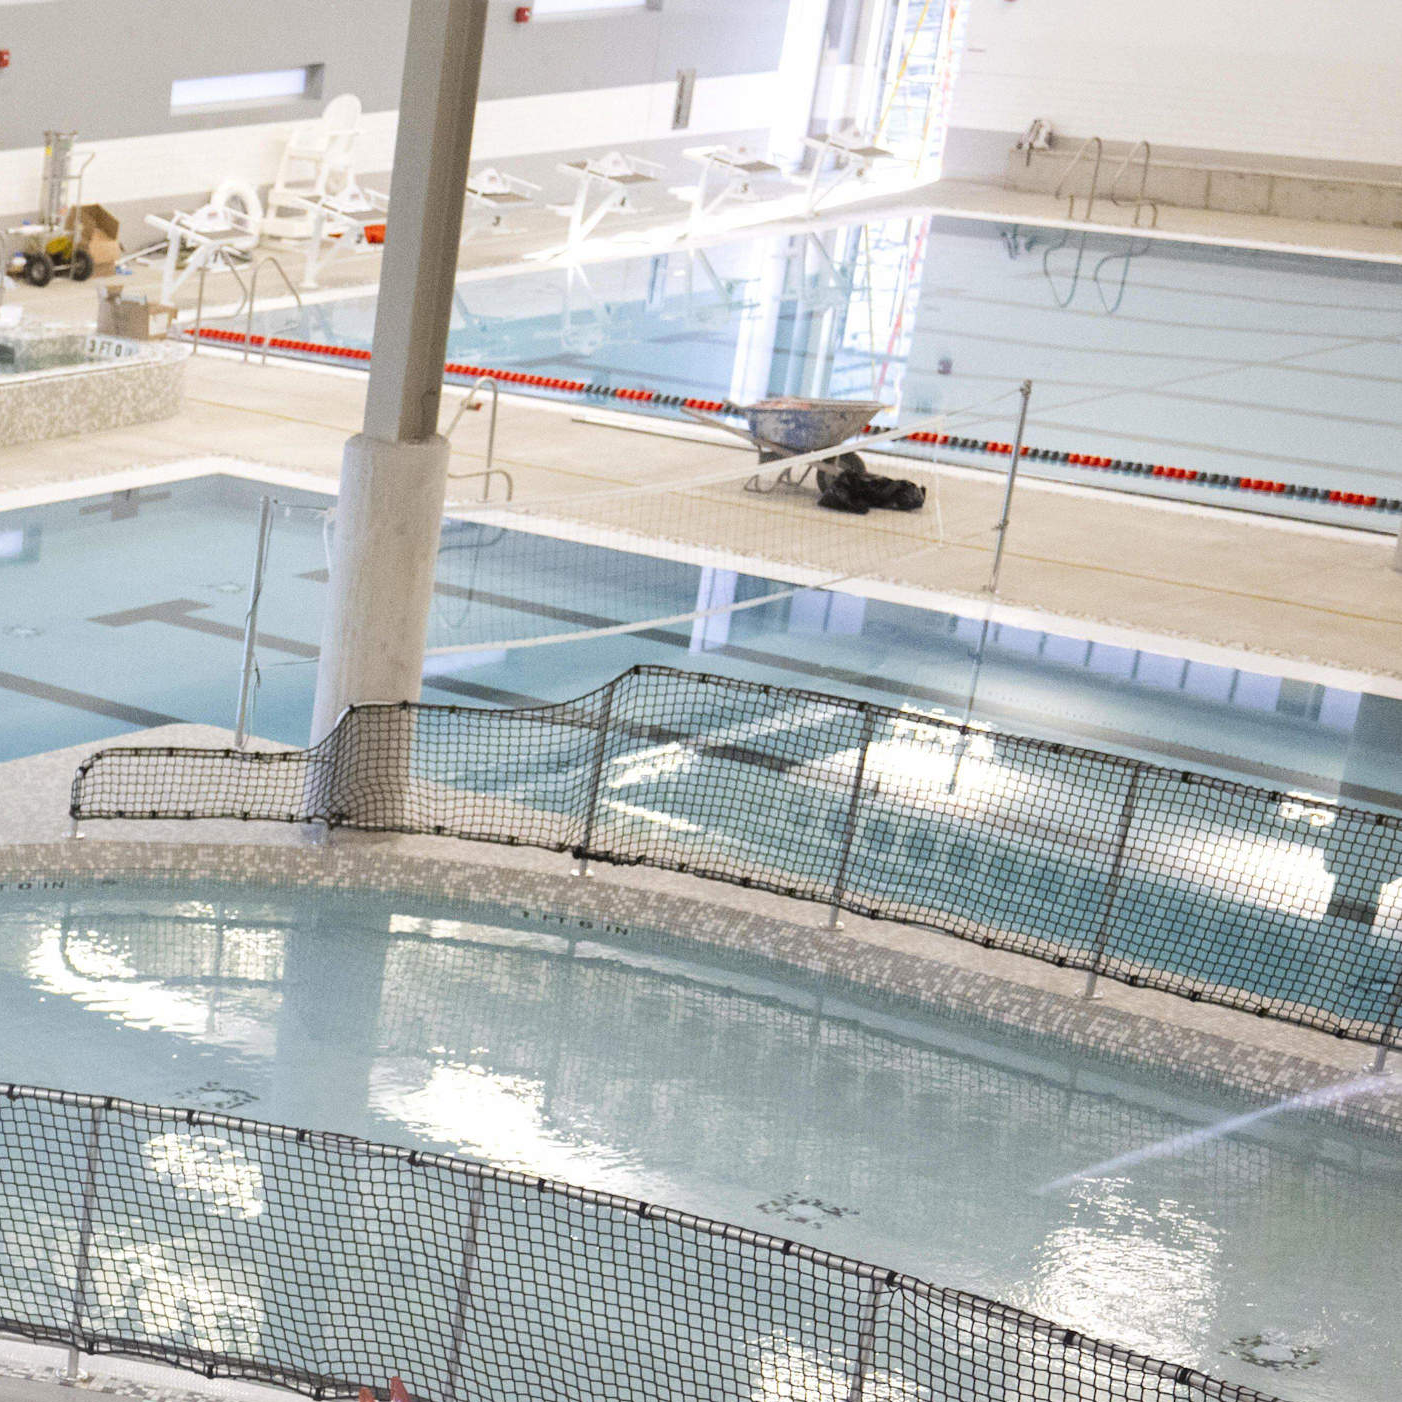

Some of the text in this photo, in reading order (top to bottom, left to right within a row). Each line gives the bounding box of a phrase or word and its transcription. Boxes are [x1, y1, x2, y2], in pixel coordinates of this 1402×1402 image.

[89, 339, 96, 353] 3
[99, 340, 113, 354] FT
[115, 343, 123, 357] 0
[44, 881, 64, 889] IN
[606, 924, 629, 936] IN
